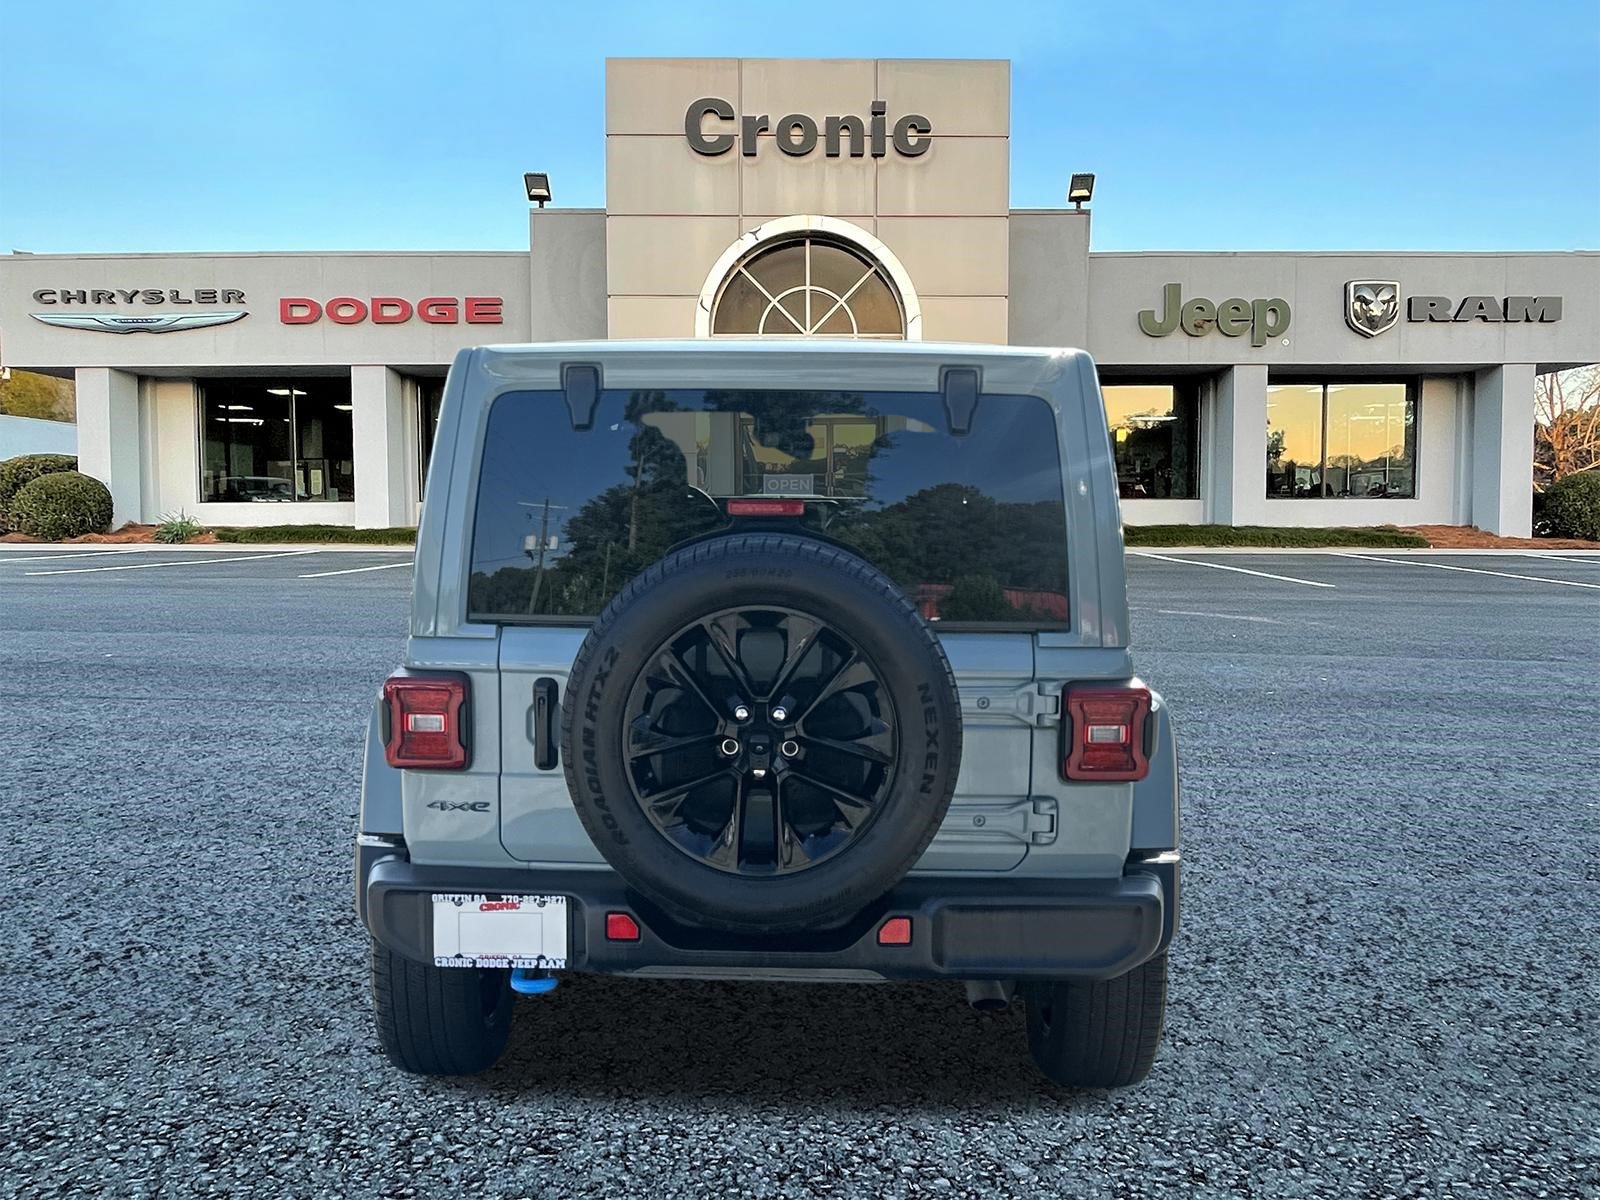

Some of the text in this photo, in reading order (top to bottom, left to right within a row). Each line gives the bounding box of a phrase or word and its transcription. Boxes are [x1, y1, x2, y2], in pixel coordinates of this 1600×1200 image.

[685, 97, 932, 158] Cronic
[32, 288, 246, 305] CHRYSLER
[279, 296, 504, 325] DODGE
[1407, 295, 1563, 323] RAM
[1138, 282, 1292, 347] Jeep
[767, 480, 810, 491] OPEN
[917, 682, 939, 794] NEXEN
[434, 957, 566, 969] CRONIC DODGE JEEP RAM
